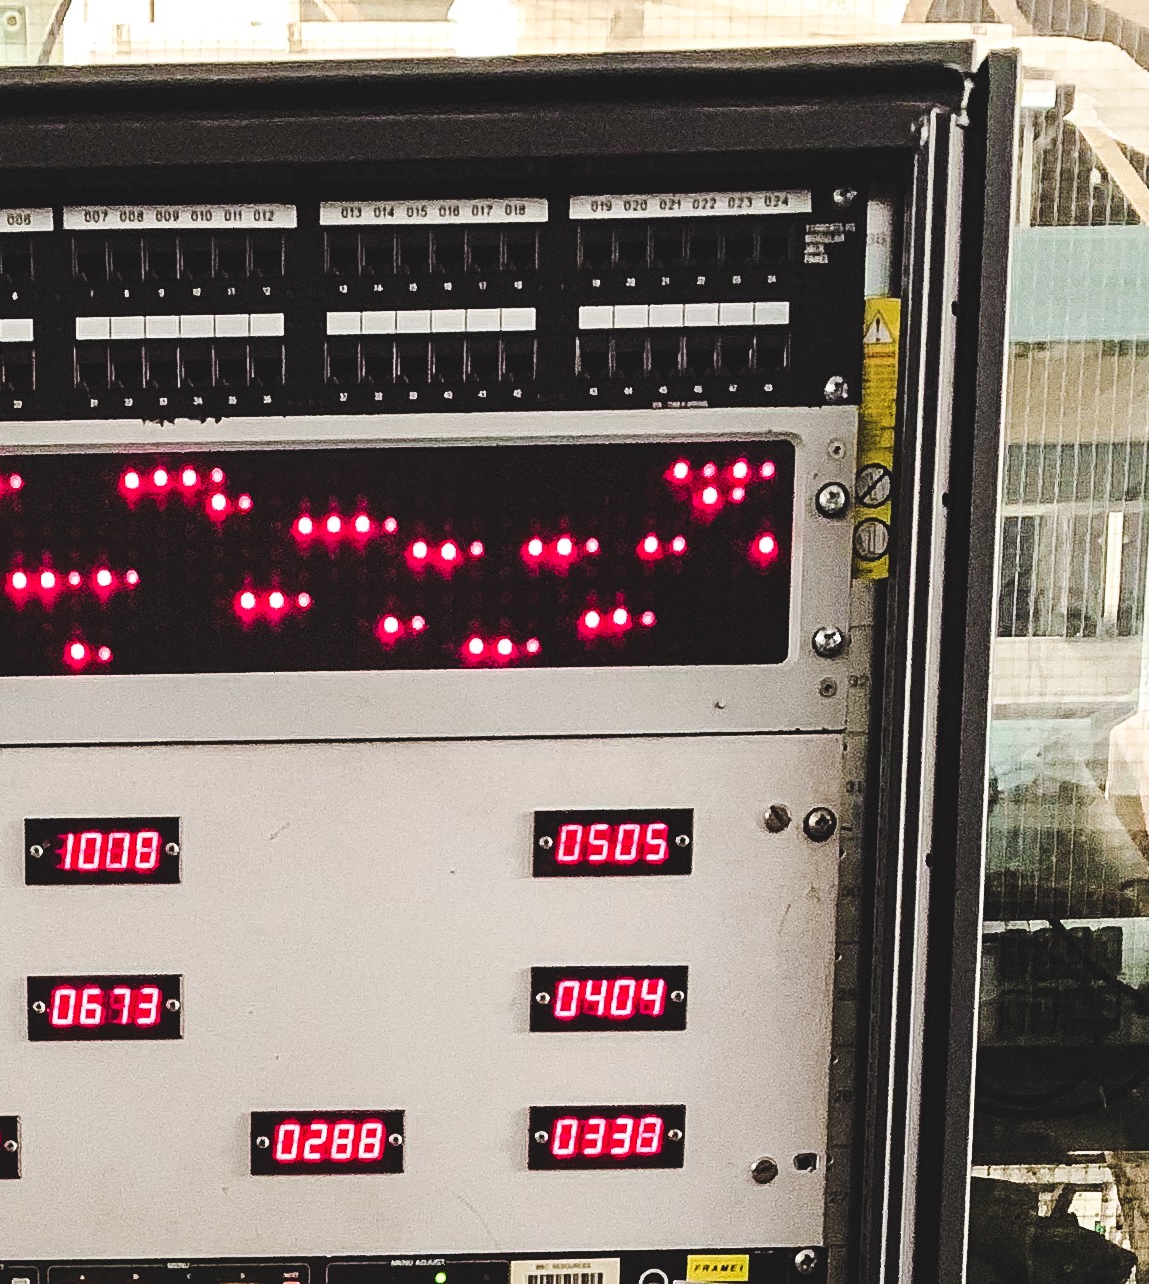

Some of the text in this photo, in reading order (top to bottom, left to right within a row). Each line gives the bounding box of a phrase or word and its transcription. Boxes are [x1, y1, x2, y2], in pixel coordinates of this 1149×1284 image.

[84, 209, 275, 223] 007 008 009 010 011 012
[340, 204, 526, 218] 013 014 015 016 017 018
[590, 200, 612, 212] 019
[623, 200, 648, 211] 020
[659, 199, 682, 210] 021
[692, 198, 717, 210] 022
[727, 197, 752, 209] 023
[62, 830, 160, 870] 1008
[558, 823, 669, 863] 0505
[50, 986, 161, 1026] 0673
[555, 978, 664, 1018] 0404
[274, 1122, 383, 1161] 0288
